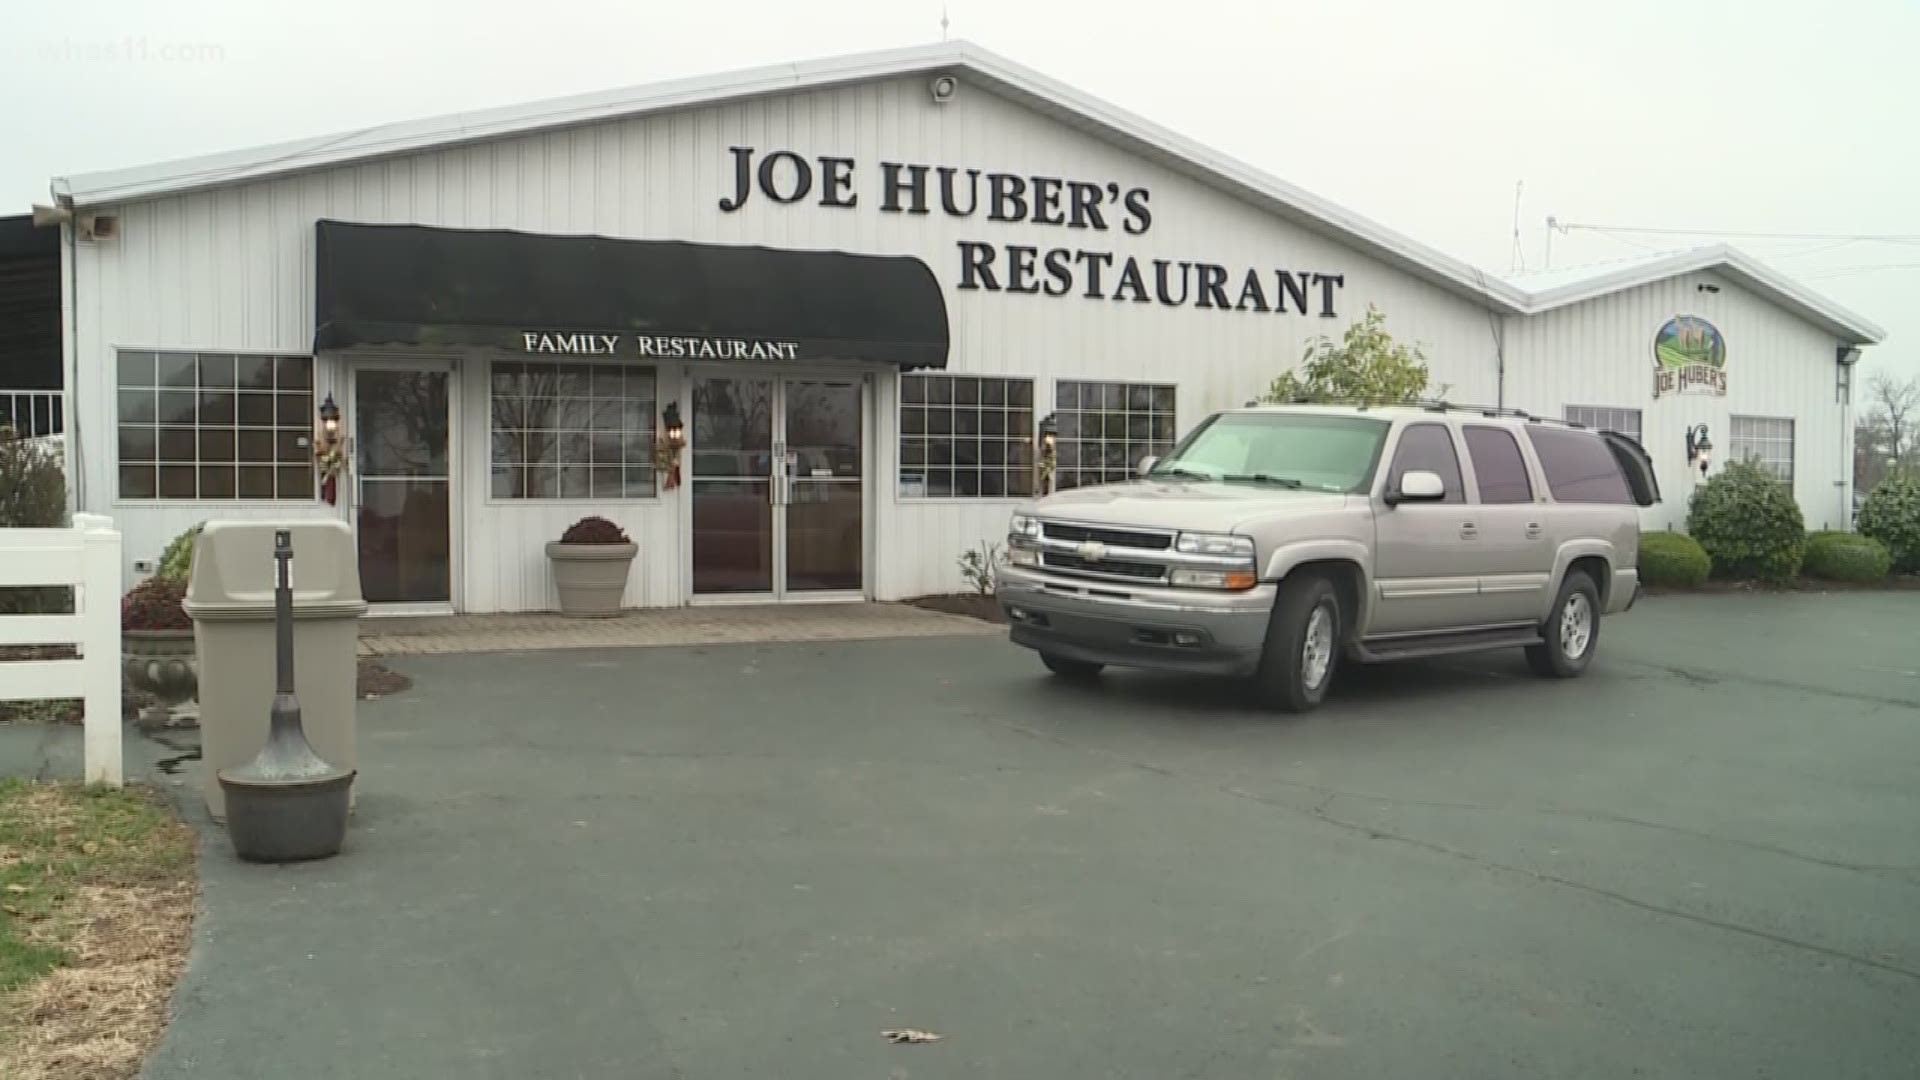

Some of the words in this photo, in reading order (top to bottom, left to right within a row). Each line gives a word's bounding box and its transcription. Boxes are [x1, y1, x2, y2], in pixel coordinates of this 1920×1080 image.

[719, 146, 858, 212] JOE
[879, 161, 1152, 234] HUBER'S
[956, 241, 1344, 318] RESTAURANT
[523, 331, 619, 355] FAMILY
[638, 335, 799, 360] RESTAURANT
[1653, 366, 1675, 399] JOE
